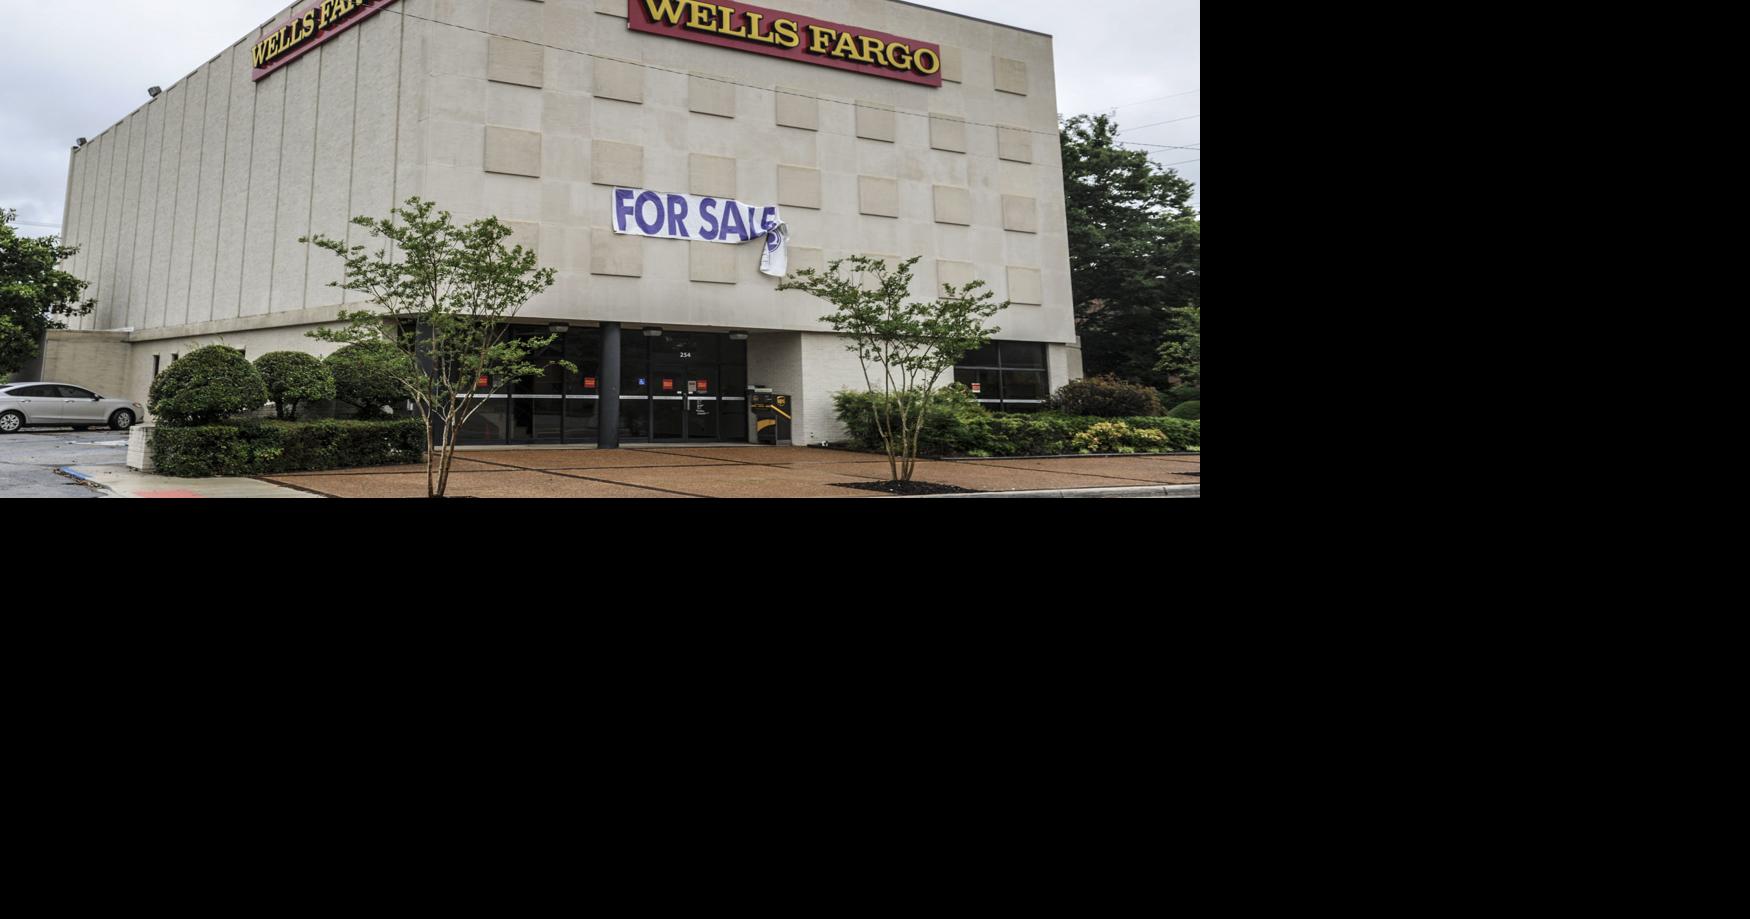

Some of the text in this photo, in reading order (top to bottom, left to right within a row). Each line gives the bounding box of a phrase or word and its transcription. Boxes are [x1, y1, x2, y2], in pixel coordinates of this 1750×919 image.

[251, 8, 315, 67] WELLS
[645, 0, 940, 74] WELLS FARGO
[615, 189, 777, 241] FOR SALE
